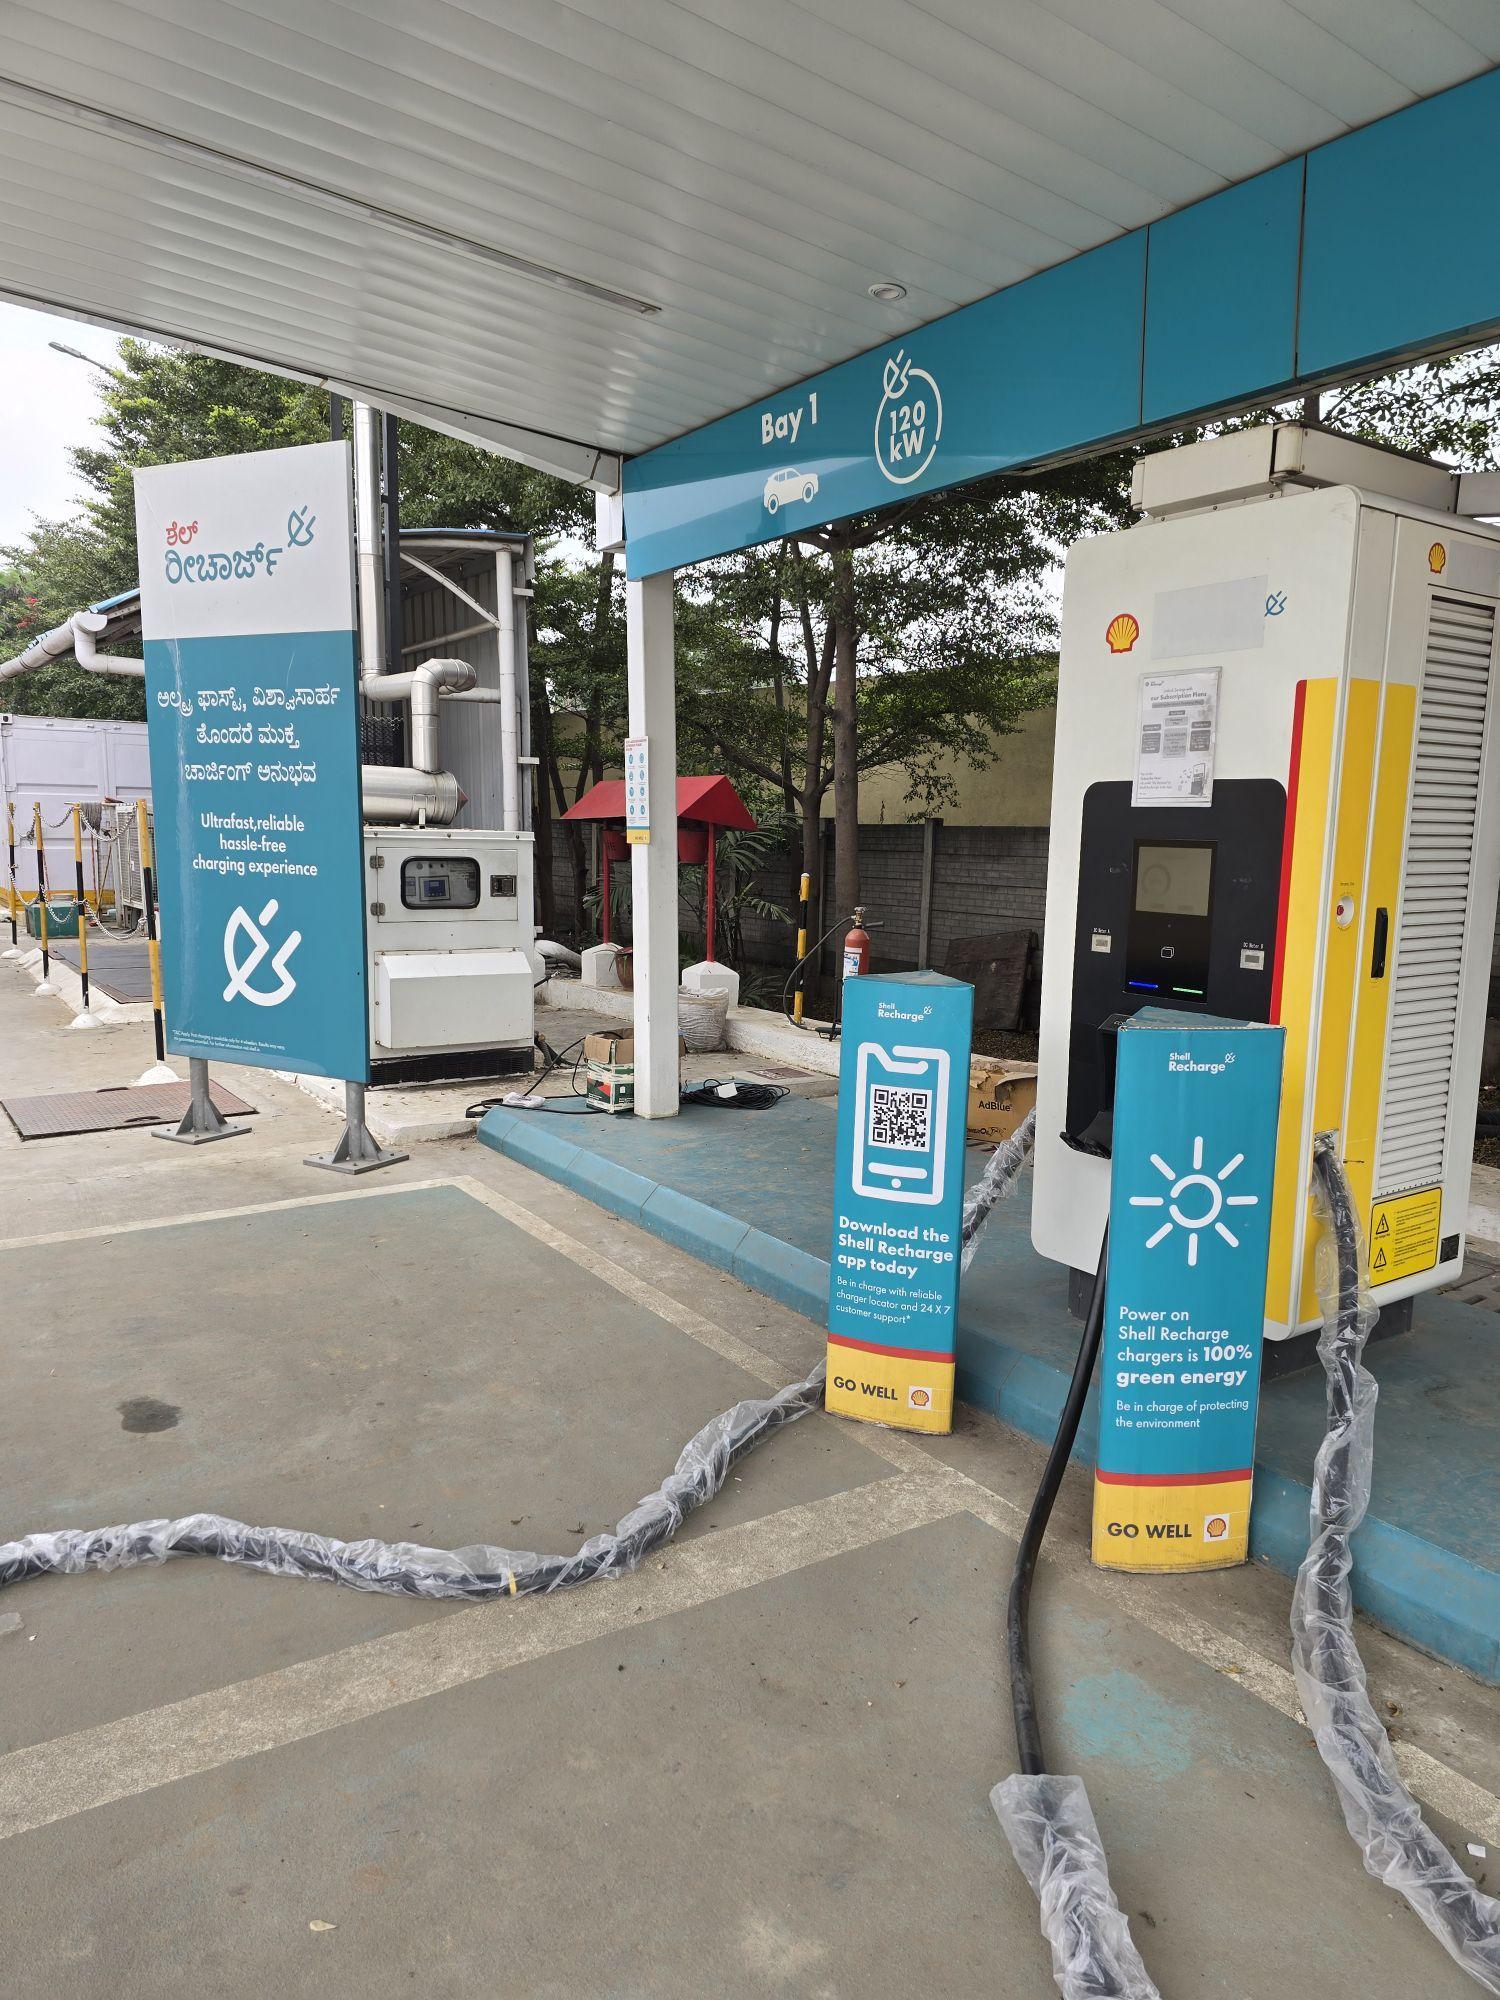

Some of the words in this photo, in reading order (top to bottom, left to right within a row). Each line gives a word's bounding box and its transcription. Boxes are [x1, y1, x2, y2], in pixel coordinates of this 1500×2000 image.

[762, 407, 803, 444] Bay
[809, 392, 817, 425] 1
[889, 400, 926, 435] 120
[890, 426, 925, 463] kW
[196, 722, 253, 744] ತೊಂದರೆ
[258, 722, 300, 749] ಮುಕ್ತ
[257, 761, 316, 786] ಅನುಭವ
[219, 833, 286, 853] hassle-free
[192, 853, 245, 875] charging
[249, 859, 318, 877] experience
[878, 1009, 925, 1022] Recharge
[1168, 1060, 1226, 1074] Recharge
[1169, 1052, 1191, 1061] Shell
[839, 1215, 918, 1240] Download
[922, 1228, 950, 1243] the
[838, 1234, 873, 1252] Shell
[878, 1240, 954, 1264] Recharge
[837, 1254, 866, 1271] app
[870, 1257, 918, 1279] today
[837, 1275, 847, 1286] Be
[849, 1278, 857, 1288] in
[858, 1281, 887, 1295] charge
[889, 1287, 907, 1297] with
[909, 1289, 942, 1301] reliable
[836, 1291, 867, 1304] charger
[869, 1295, 898, 1309] locator
[901, 1302, 918, 1312] and
[920, 1303, 933, 1313] 24
[944, 1306, 951, 1315] 7
[836, 1305, 871, 1318] customer
[1119, 1306, 1166, 1321] Power
[1171, 1311, 1189, 1321] on
[1118, 1325, 1155, 1341] Shell
[1160, 1326, 1229, 1343] Recharge
[1117, 1347, 1183, 1366] chargers
[1188, 1349, 1198, 1362] is
[1203, 1344, 1253, 1362] 100%
[833, 1375, 857, 1392] GO
[861, 1382, 898, 1401] WELL
[1116, 1371, 1175, 1387] green
[1180, 1370, 1247, 1387] energy
[1116, 1400, 1131, 1411] Be
[1134, 1401, 1143, 1412] in
[1146, 1401, 1183, 1414] charge
[1186, 1400, 1198, 1412] of
[1200, 1399, 1249, 1414] protecting
[1115, 1416, 1133, 1428] the
[1136, 1418, 1200, 1428] environment
[1107, 1522, 1139, 1538] GO
[1146, 1523, 1192, 1538] WELL
